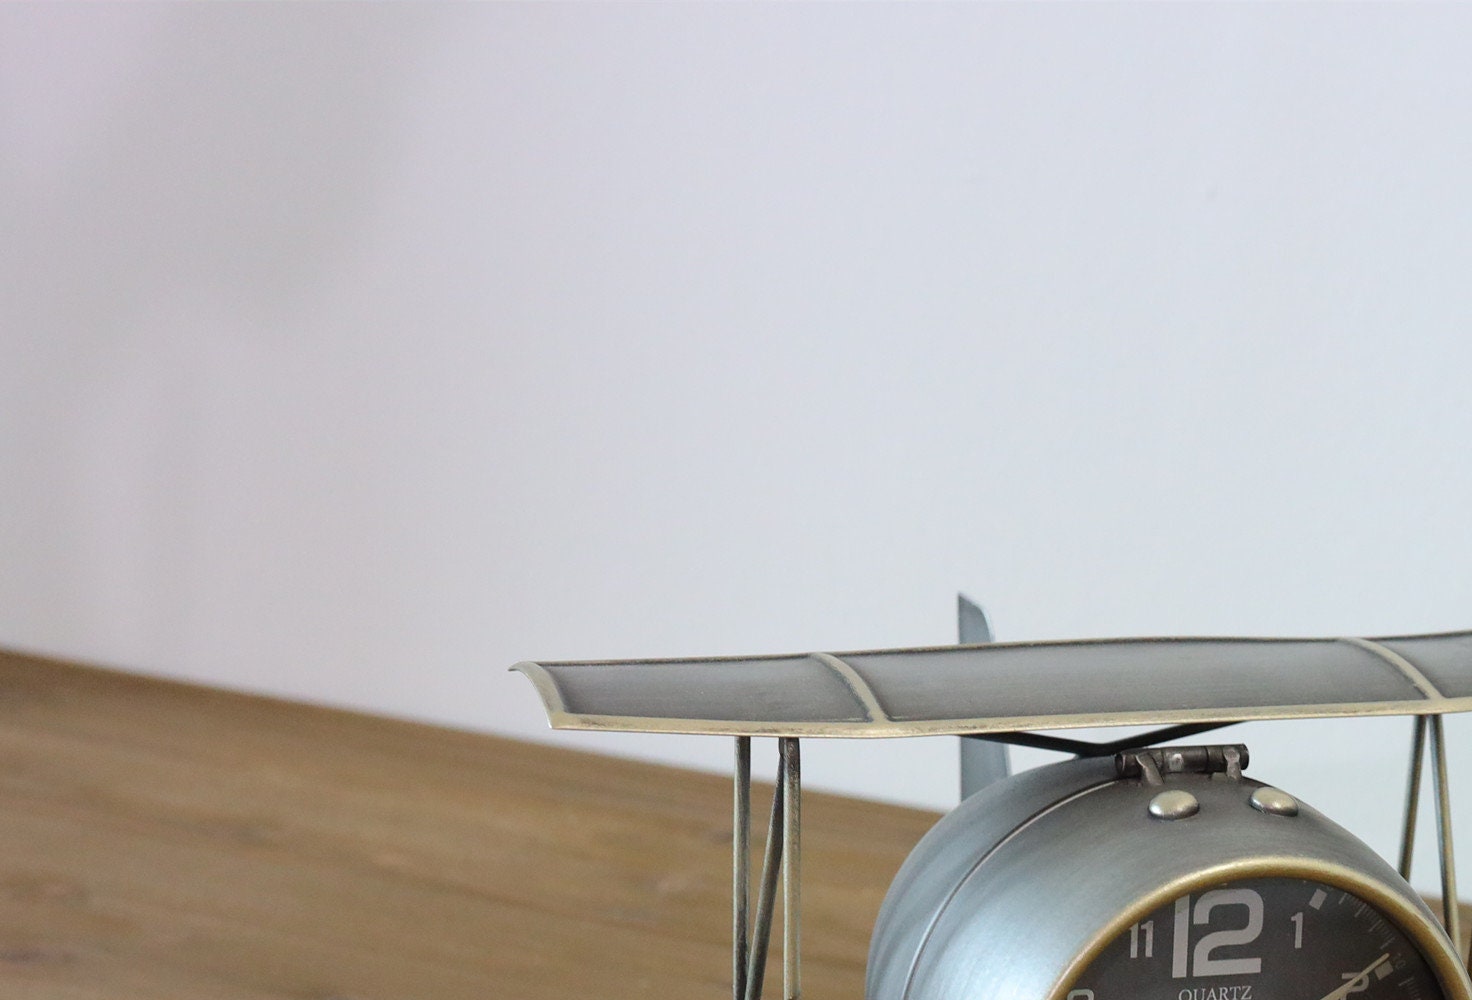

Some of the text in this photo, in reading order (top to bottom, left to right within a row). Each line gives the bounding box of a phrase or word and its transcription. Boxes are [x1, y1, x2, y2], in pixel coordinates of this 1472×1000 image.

[1129, 920, 1154, 959] 11
[1172, 888, 1264, 978] 12
[1291, 912, 1303, 949] 1
